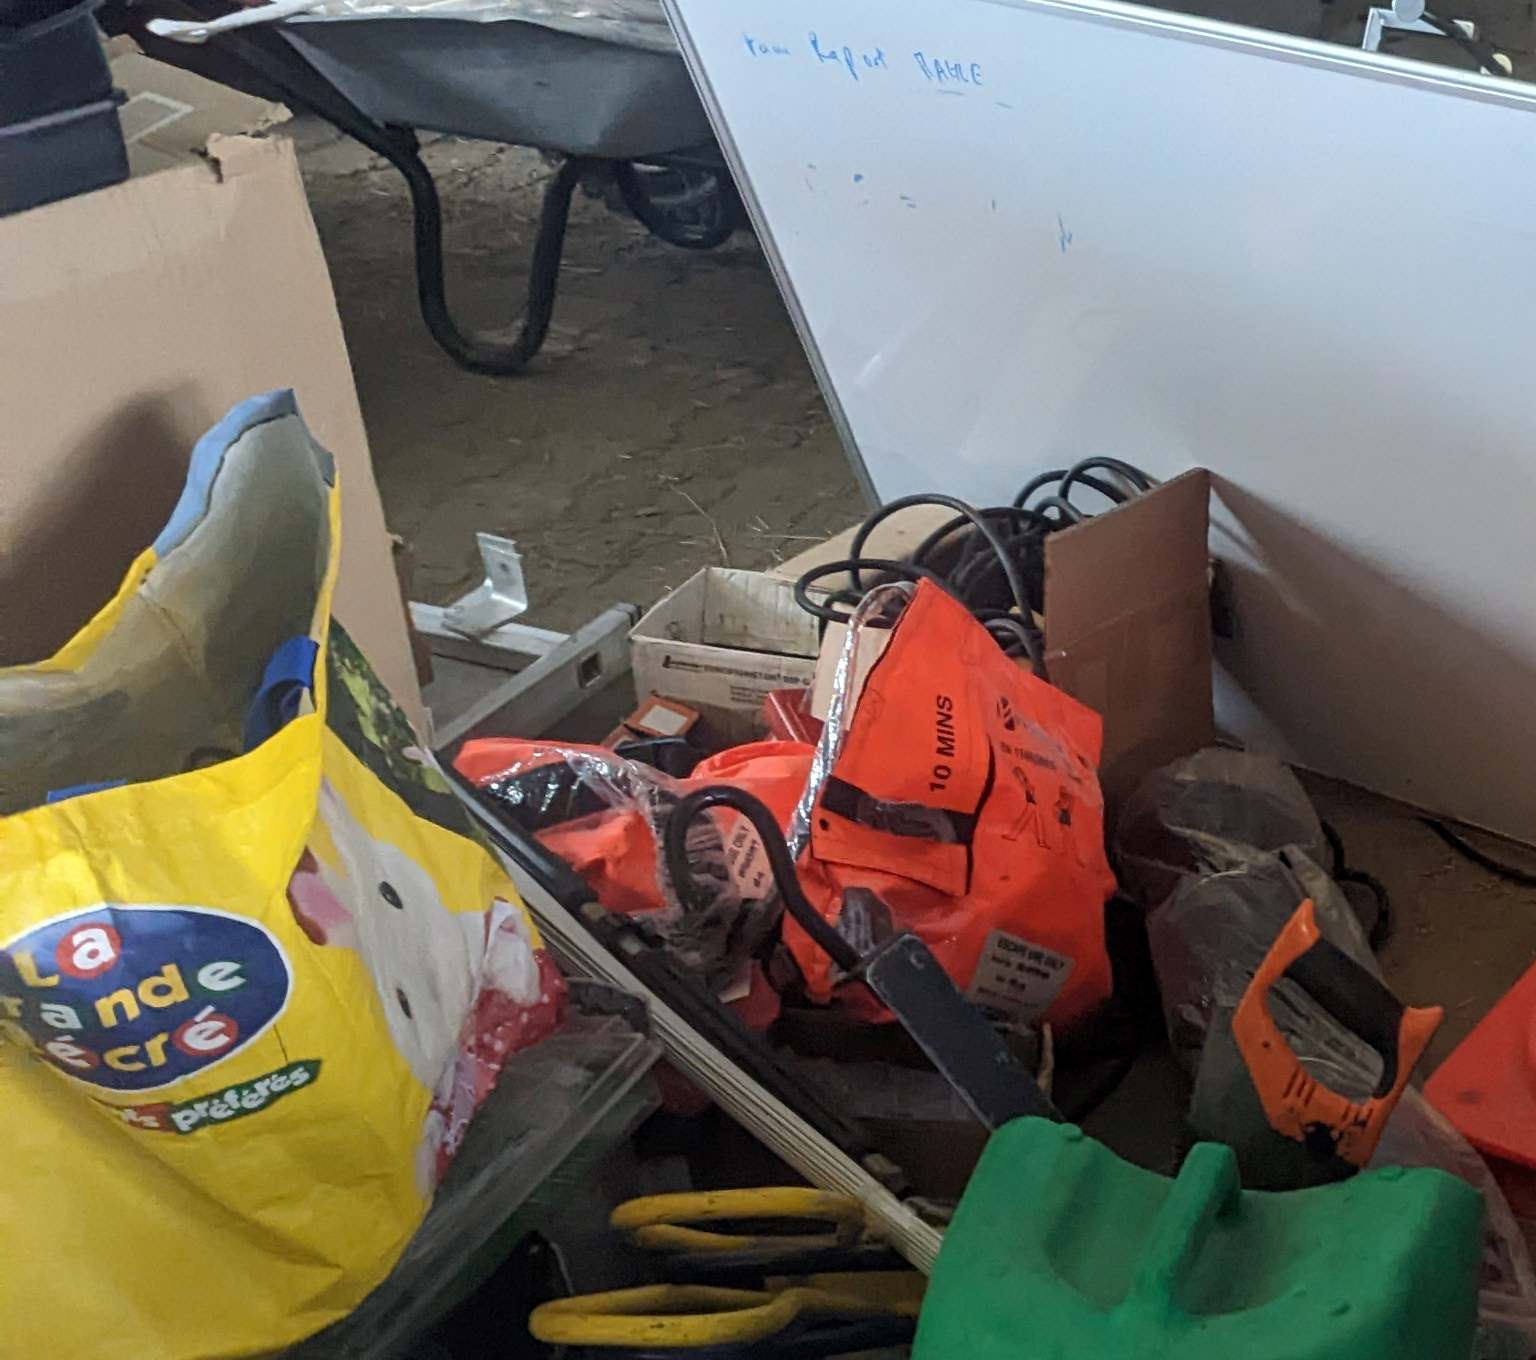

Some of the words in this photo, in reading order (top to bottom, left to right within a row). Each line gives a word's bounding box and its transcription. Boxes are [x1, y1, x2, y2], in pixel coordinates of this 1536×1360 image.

[936, 694, 956, 758] MINS
[930, 764, 952, 792] 10
[11, 926, 117, 988] La
[170, 1066, 311, 1132] préférés
